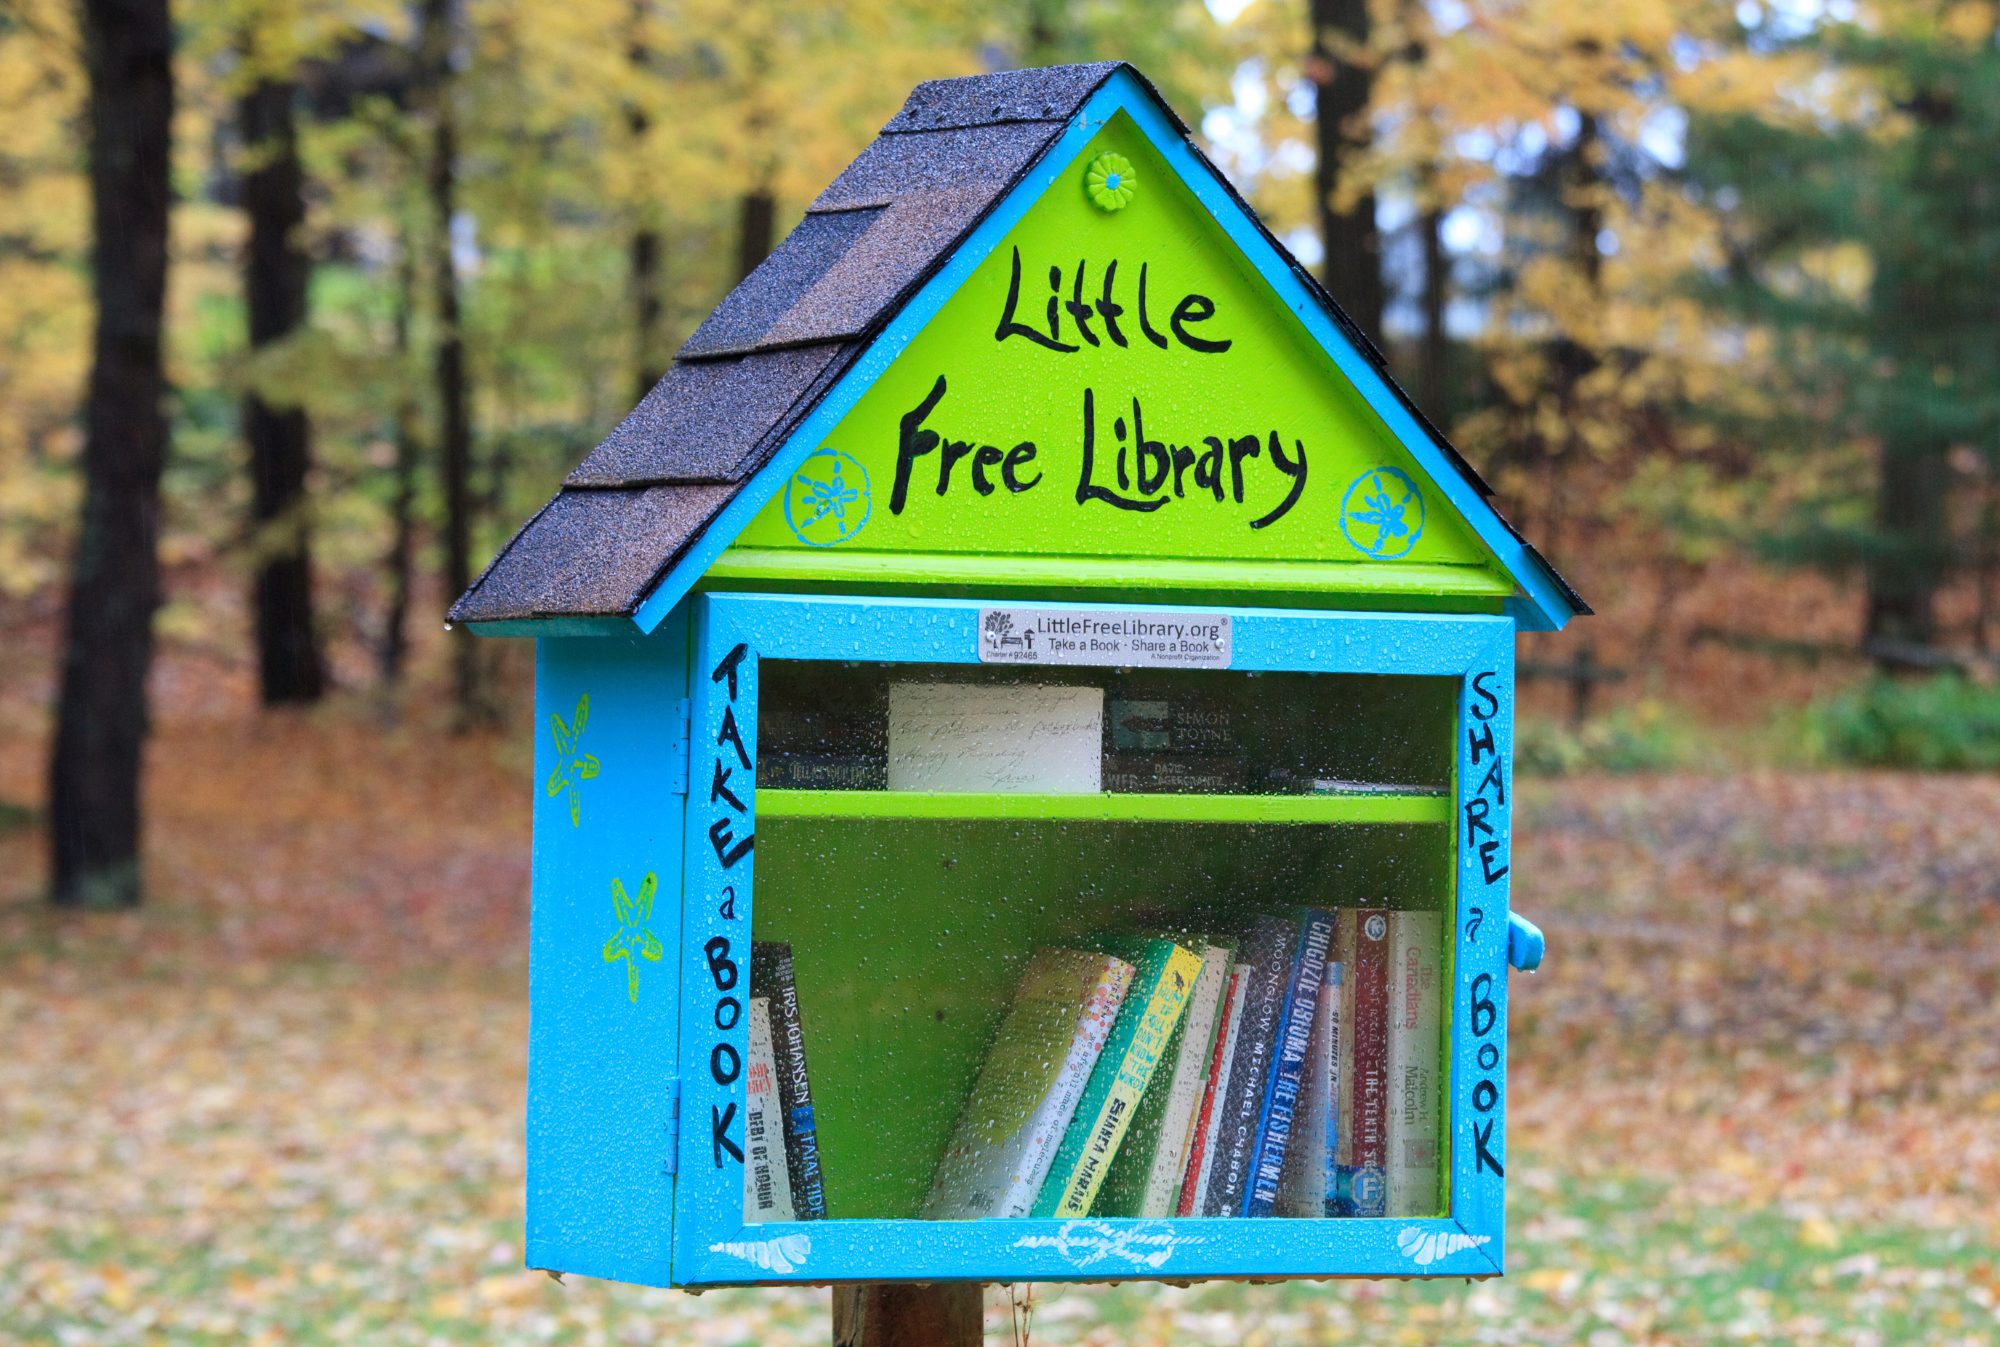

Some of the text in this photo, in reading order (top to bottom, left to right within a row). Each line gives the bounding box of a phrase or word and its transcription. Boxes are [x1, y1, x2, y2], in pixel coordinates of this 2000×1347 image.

[995, 245, 1232, 353] Little
[889, 374, 1307, 530] Free Library
[1037, 617, 1220, 640] LittleFreeLibrary.org
[1049, 638, 1209, 653] Take a Book Share a Book
[1156, 654, 1183, 662] Nonprofit
[1184, 654, 1221, 662] Organization
[709, 643, 754, 869] TAKE
[1464, 672, 1509, 885] SHARE
[782, 985, 798, 1019] IRIS
[1259, 933, 1288, 1033] MOONGLOW
[1281, 920, 1333, 1064] CHIGOZIE OBIOMA
[1405, 946, 1422, 1030] Canadians
[1420, 966, 1432, 990] The
[704, 937, 745, 1169] BOOK
[786, 1021, 810, 1105] JOHANSEN
[1241, 1042, 1264, 1120] MICHAEL
[1331, 1026, 1339, 1067] MINUTES
[749, 1111, 767, 1142] DEBT
[1364, 1098, 1378, 1143] TENTH
[1404, 1065, 1418, 1126] Malcolm
[1225, 1125, 1248, 1196] CHABON
[1254, 1071, 1300, 1204] THE FISHERMEN
